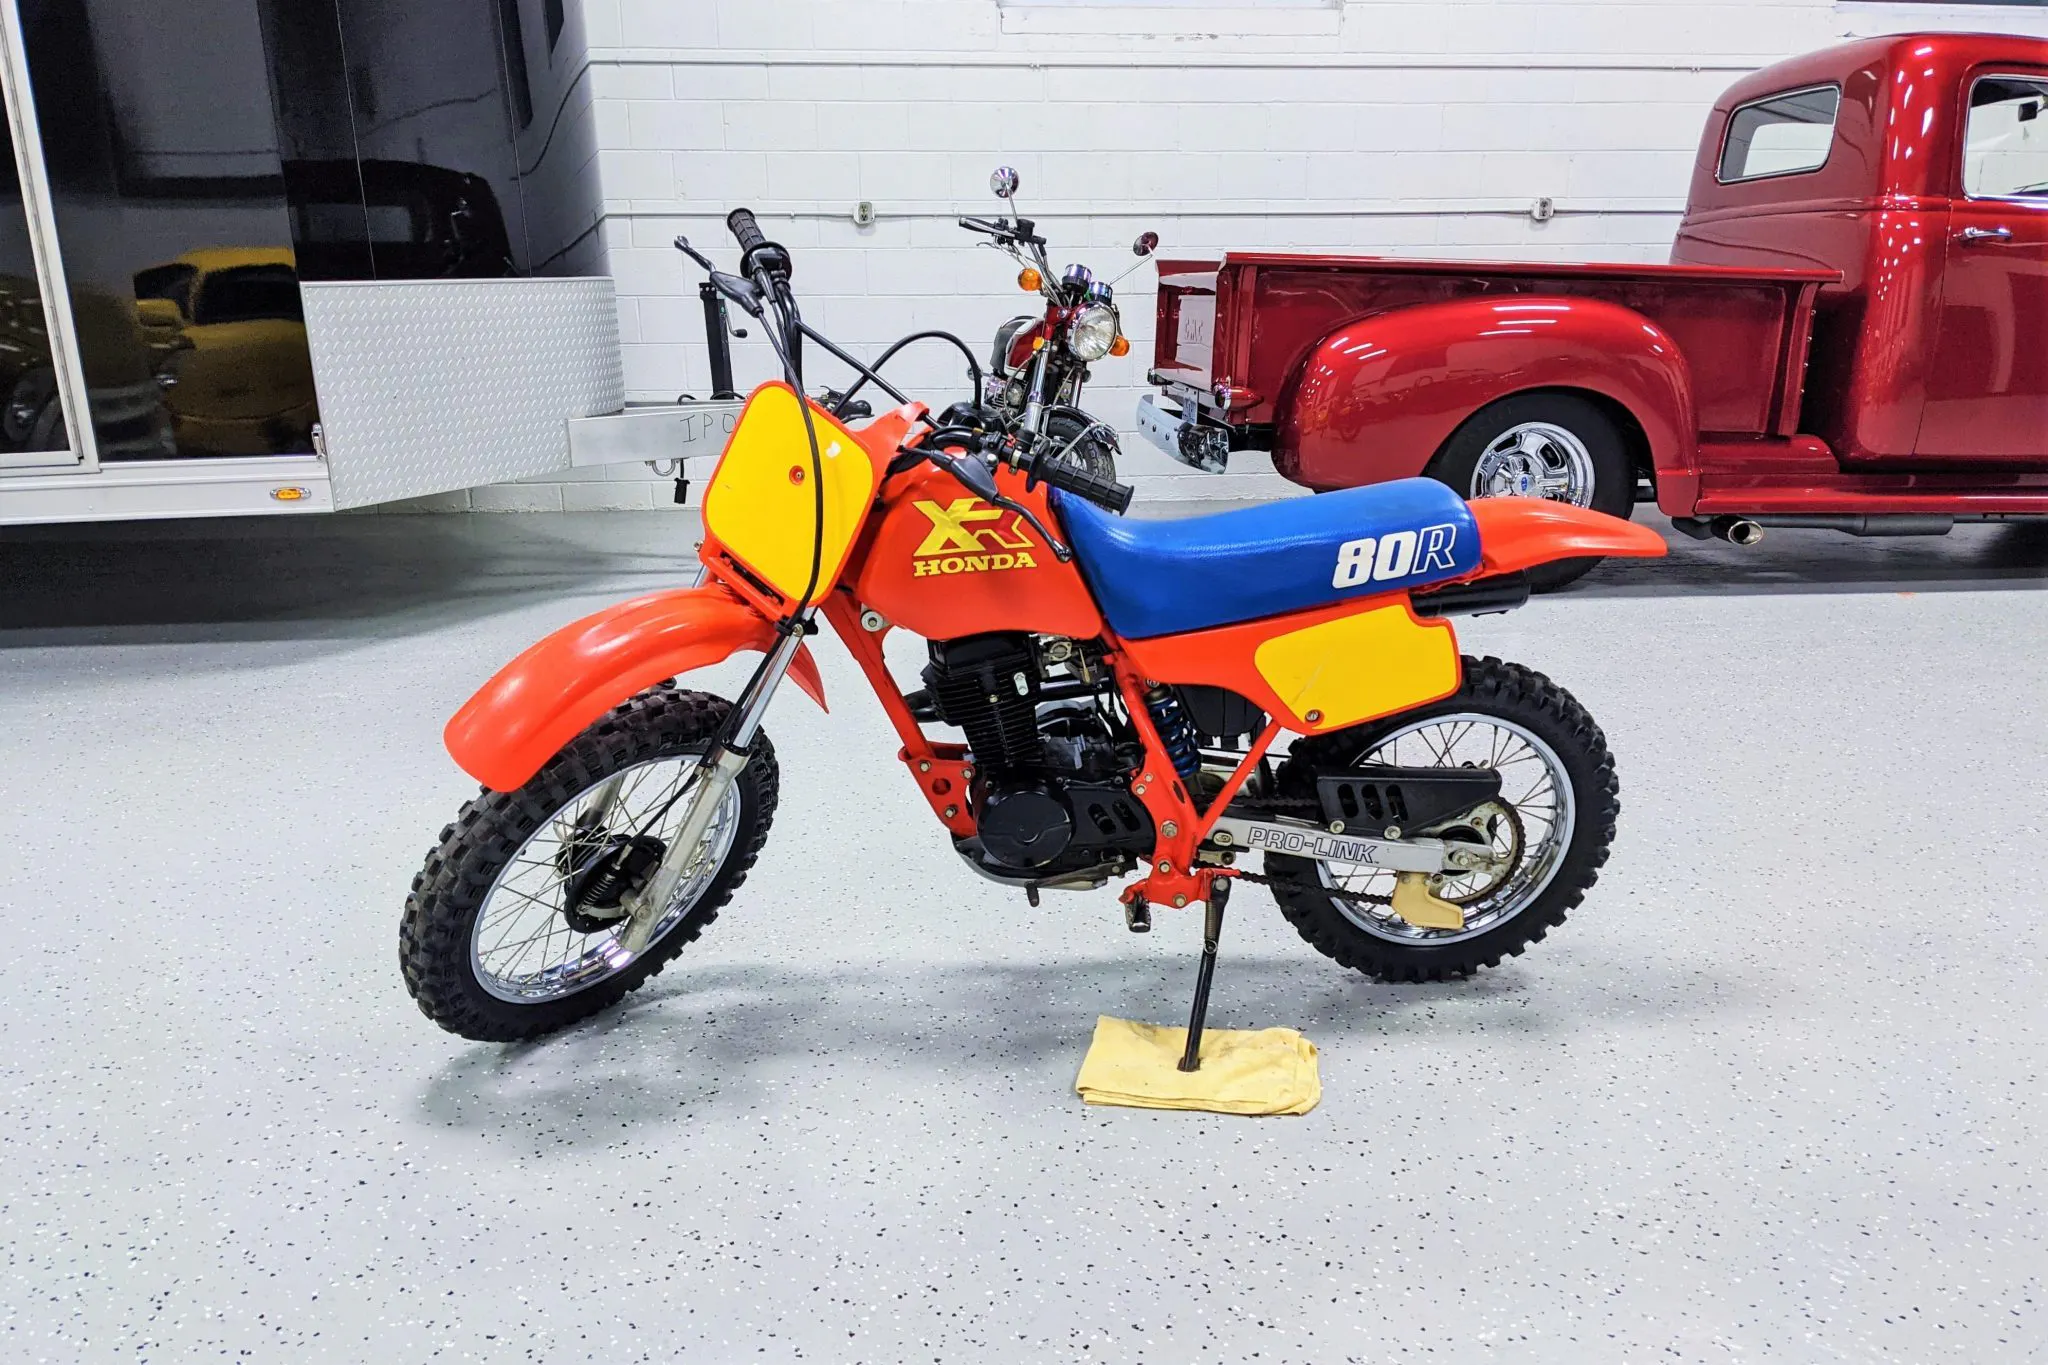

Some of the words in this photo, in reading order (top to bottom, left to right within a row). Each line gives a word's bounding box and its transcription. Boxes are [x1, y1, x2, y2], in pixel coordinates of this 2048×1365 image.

[912, 496, 1036, 557] XR
[912, 552, 1037, 577] HONDA
[1332, 523, 1457, 589] 80R
[1247, 826, 1378, 864] PRO-LINK
